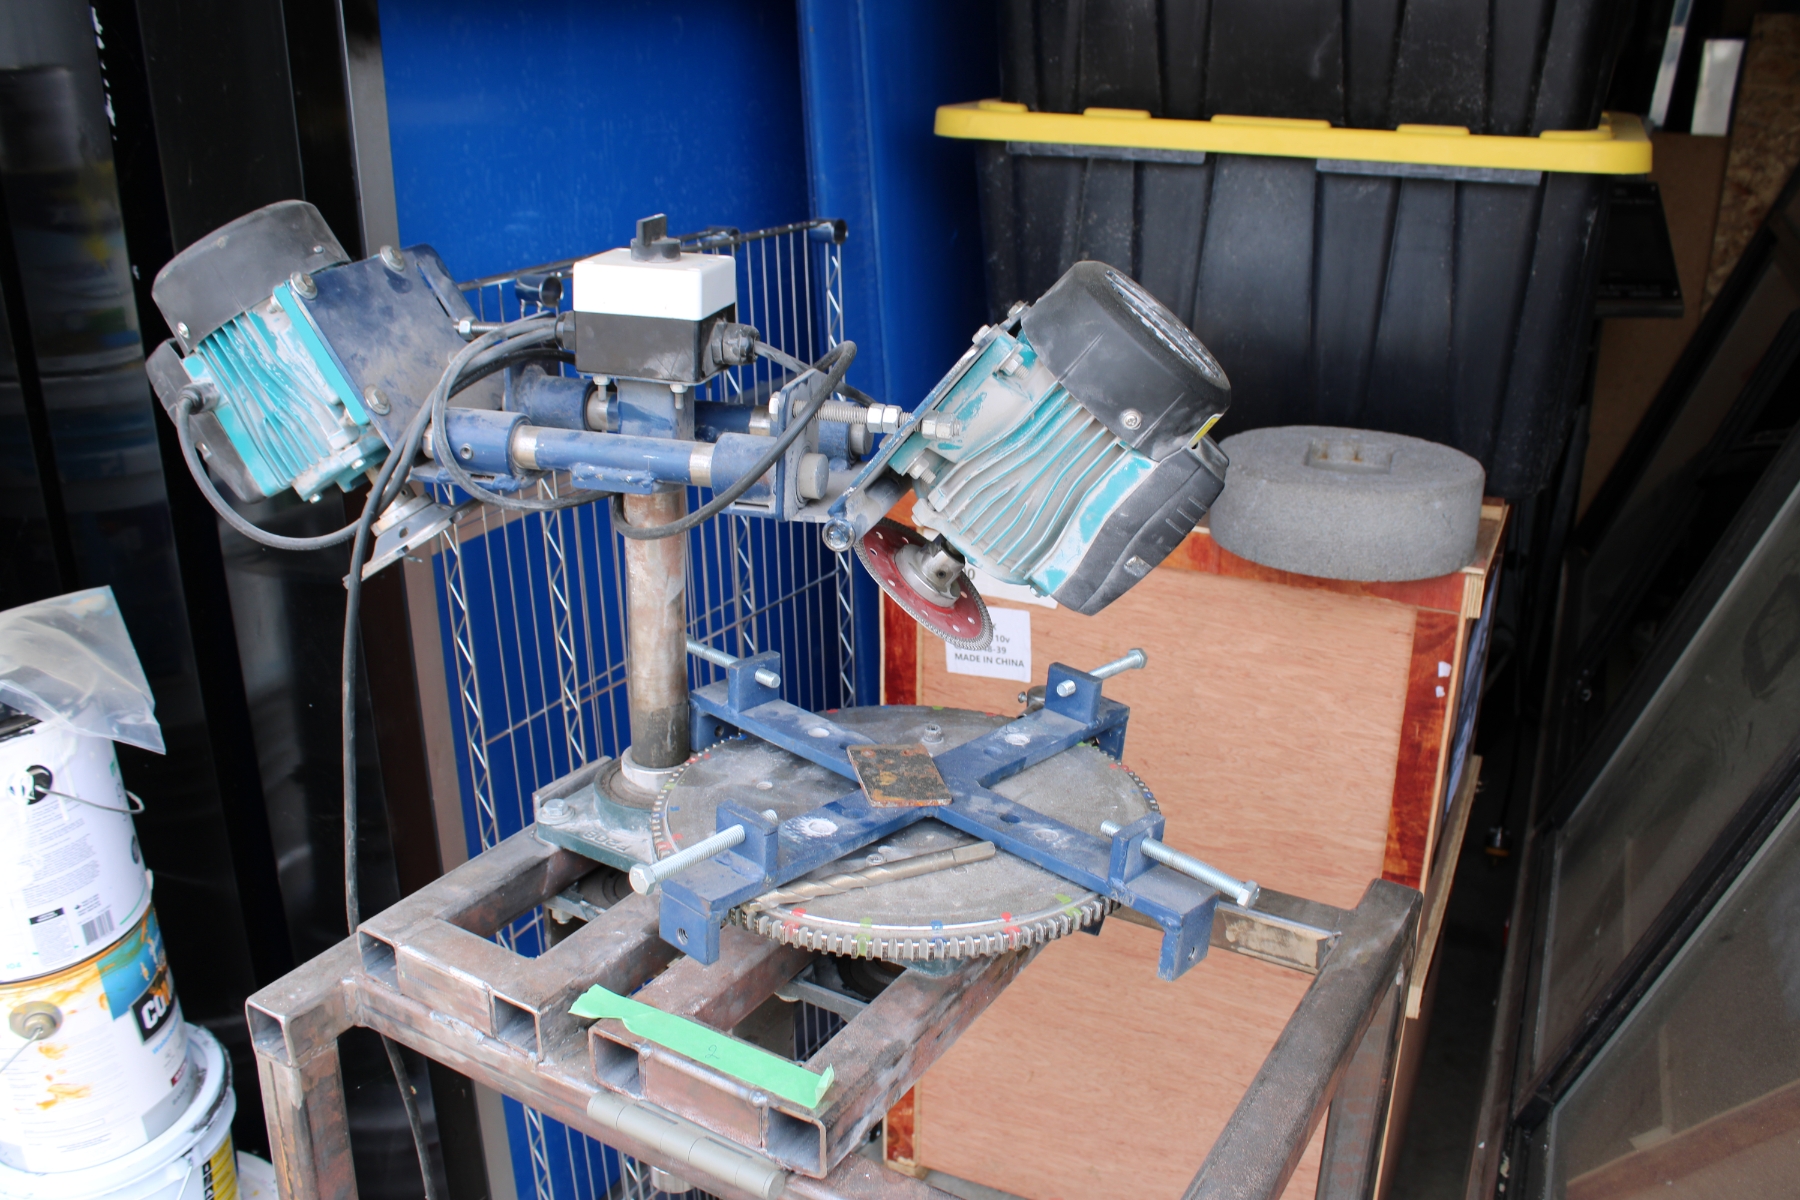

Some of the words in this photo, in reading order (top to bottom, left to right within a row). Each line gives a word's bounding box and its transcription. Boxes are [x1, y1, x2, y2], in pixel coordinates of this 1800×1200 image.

[954, 652, 980, 662] MADE
[983, 655, 993, 664] IN
[995, 657, 1025, 667] CHINA
[704, 1044, 720, 1060] 2
